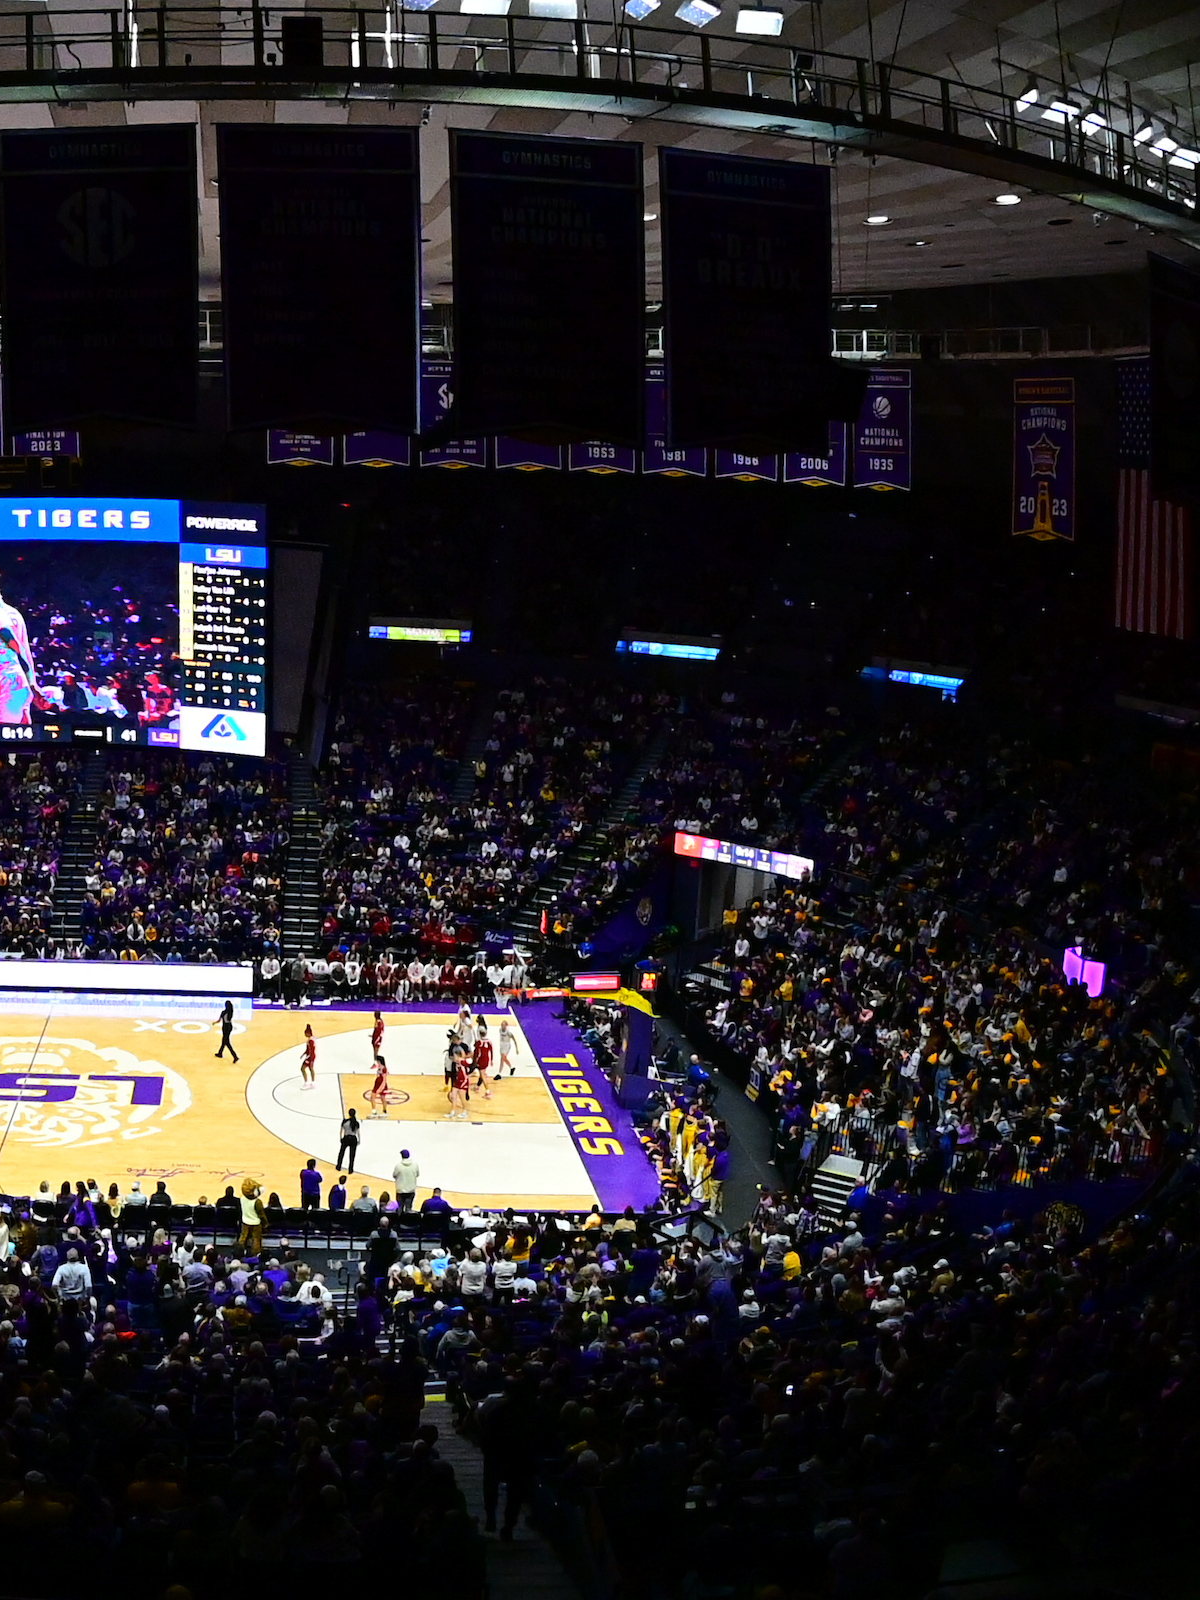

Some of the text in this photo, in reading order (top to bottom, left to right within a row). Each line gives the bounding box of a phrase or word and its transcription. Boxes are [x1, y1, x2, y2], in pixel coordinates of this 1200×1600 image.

[501, 150, 593, 170] GYMNASTICS
[706, 170, 787, 190] GYMNASTICS
[56, 187, 138, 268] SEC
[1021, 416, 1068, 431] CHAMPIONS
[864, 427, 900, 438] NATIONAL
[30, 440, 62, 452] 2023
[858, 436, 904, 448] CHAMPIONS
[867, 457, 895, 471] 1935
[1019, 496, 1036, 514] 20
[1051, 498, 1068, 517] 23
[12, 508, 153, 530] TIGERS
[186, 515, 259, 532] POWERADE
[205, 547, 242, 563] LSU
[121, 729, 137, 742] 41
[151, 731, 178, 743] LSU
[133, 1017, 247, 1036] COX
[541, 1053, 625, 1158] TIGERS
